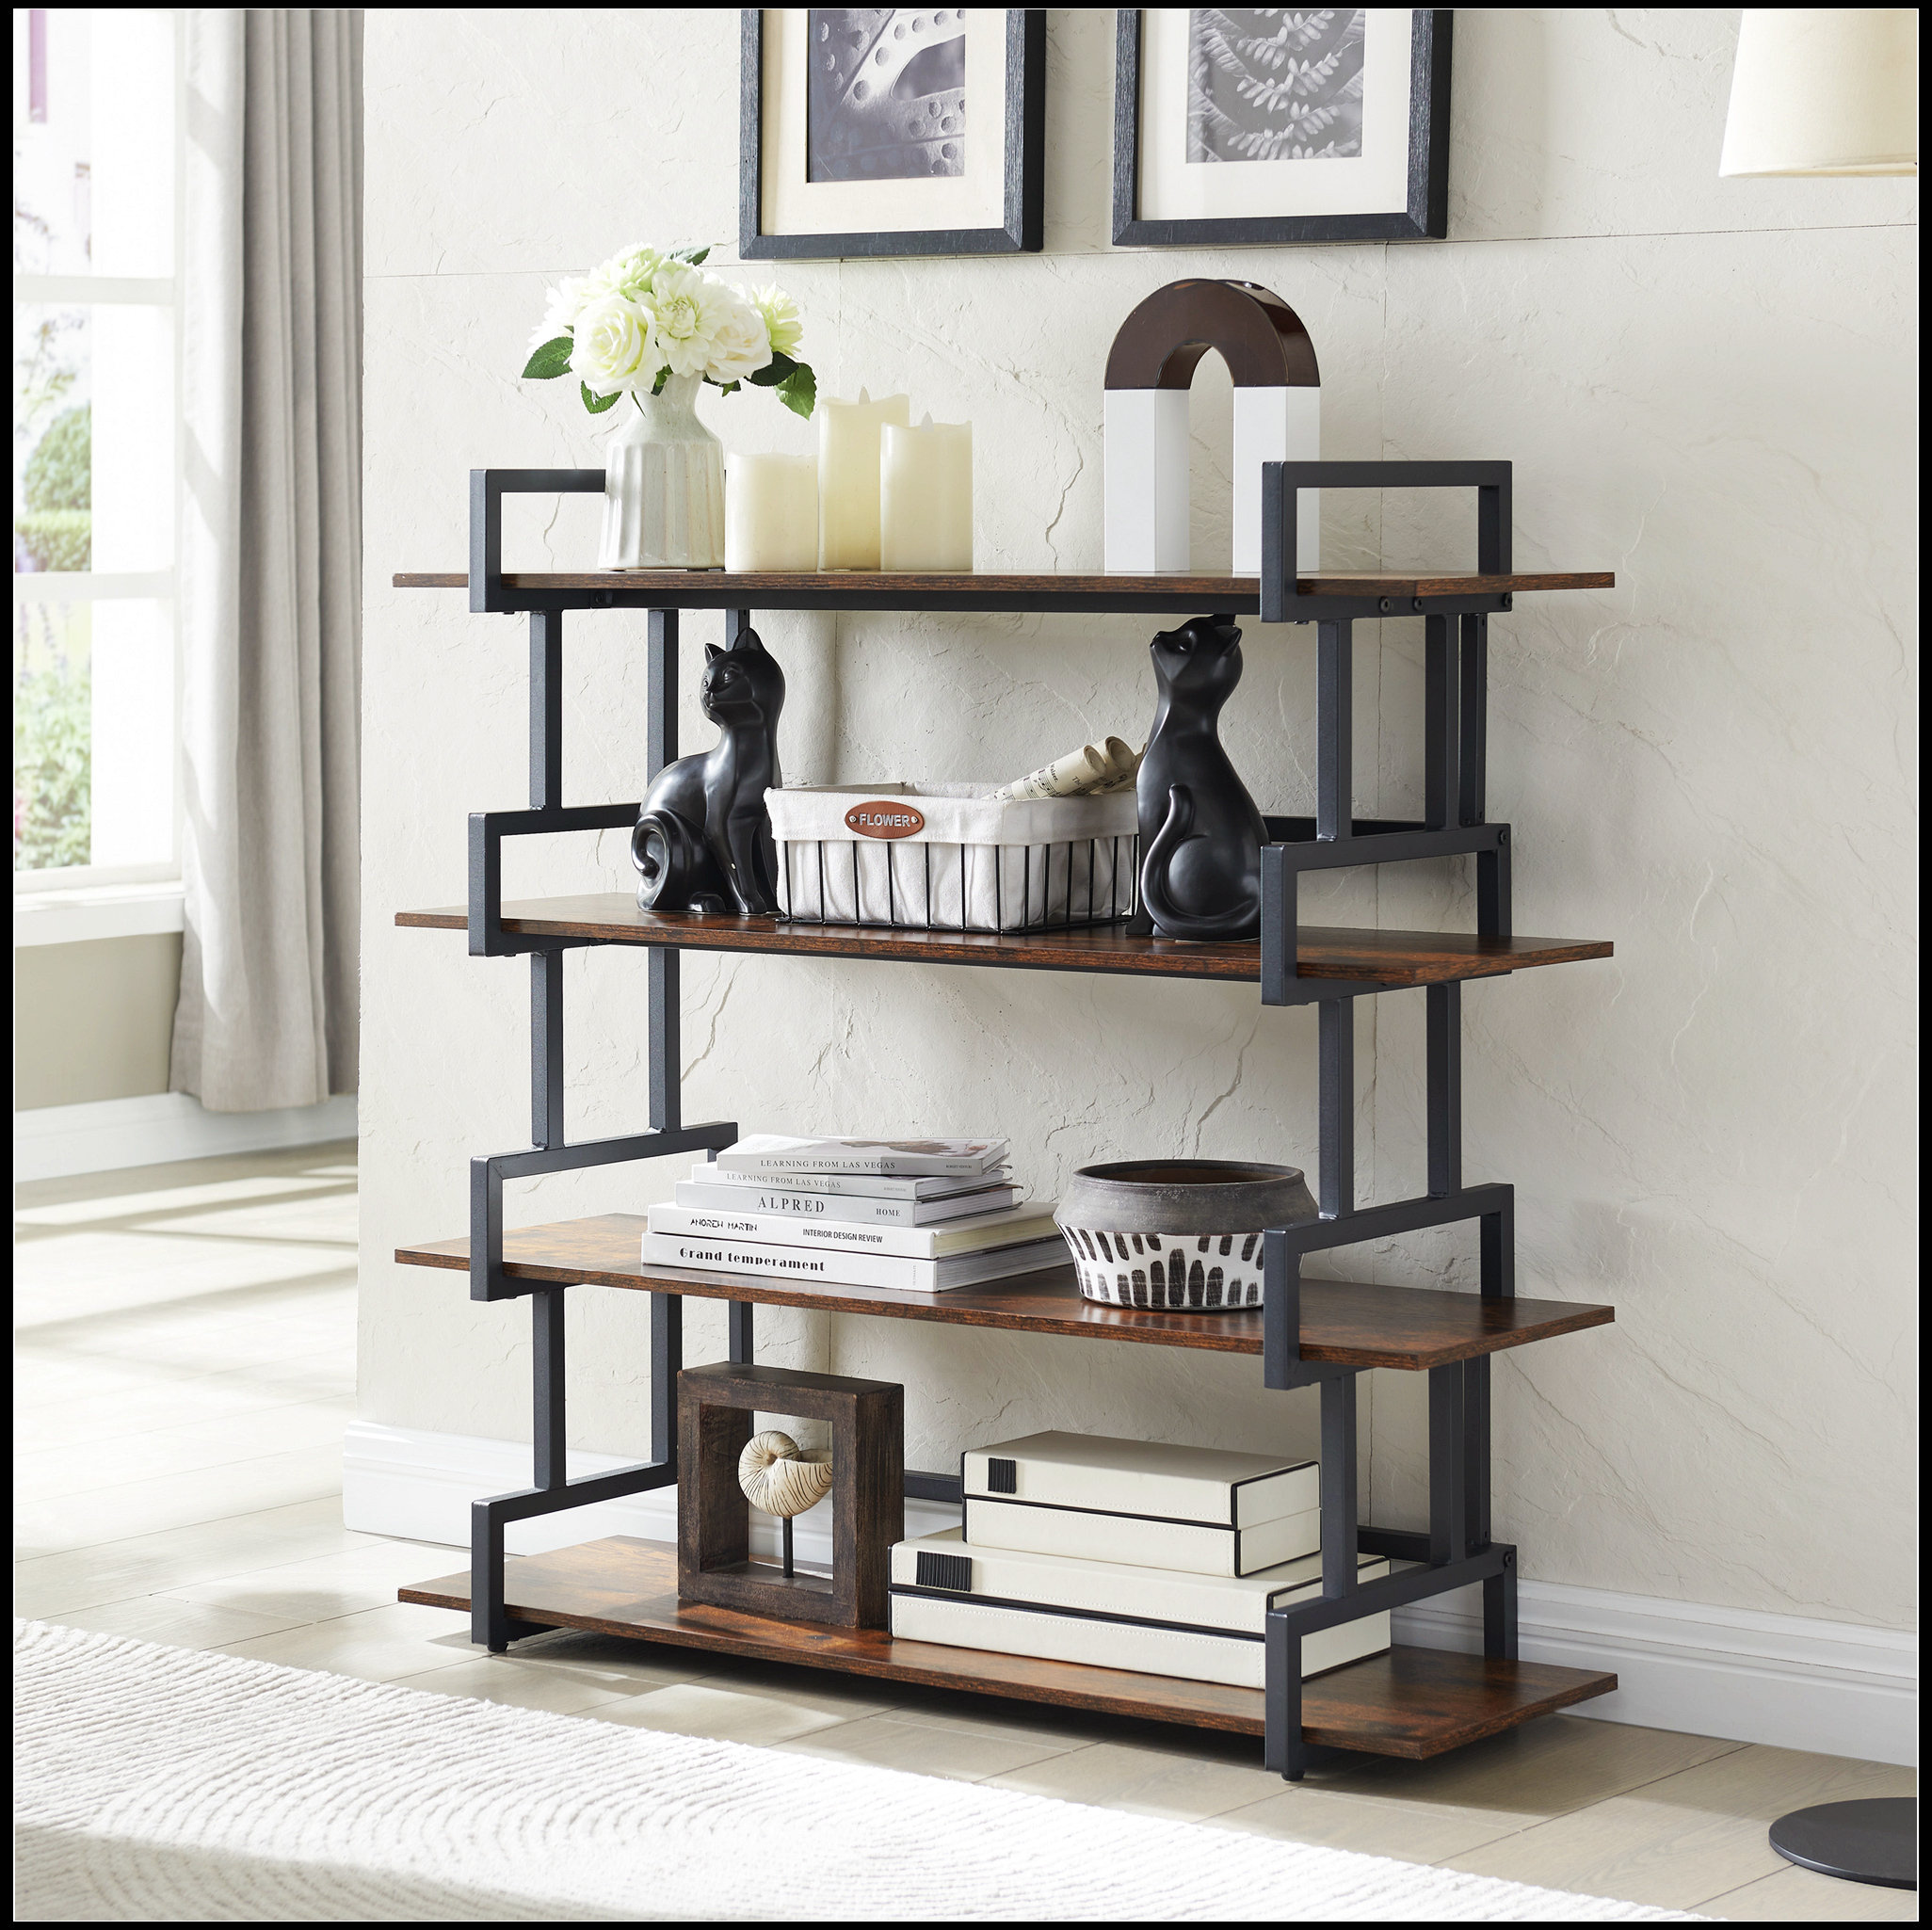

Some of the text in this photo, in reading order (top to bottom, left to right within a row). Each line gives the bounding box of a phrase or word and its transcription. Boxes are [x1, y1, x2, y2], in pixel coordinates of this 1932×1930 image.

[859, 812, 910, 828] FLOWER
[864, 1161, 895, 1169] VEGAS
[727, 1173, 841, 1189] LEARNING FROM LAS VEGAS
[758, 1197, 901, 1217] ALPRED HOME
[727, 1222, 758, 1232] MARTIN
[803, 1228, 883, 1244] INTERIOR DESIGN REVIEW
[679, 1246, 824, 1272] Grand temperament
